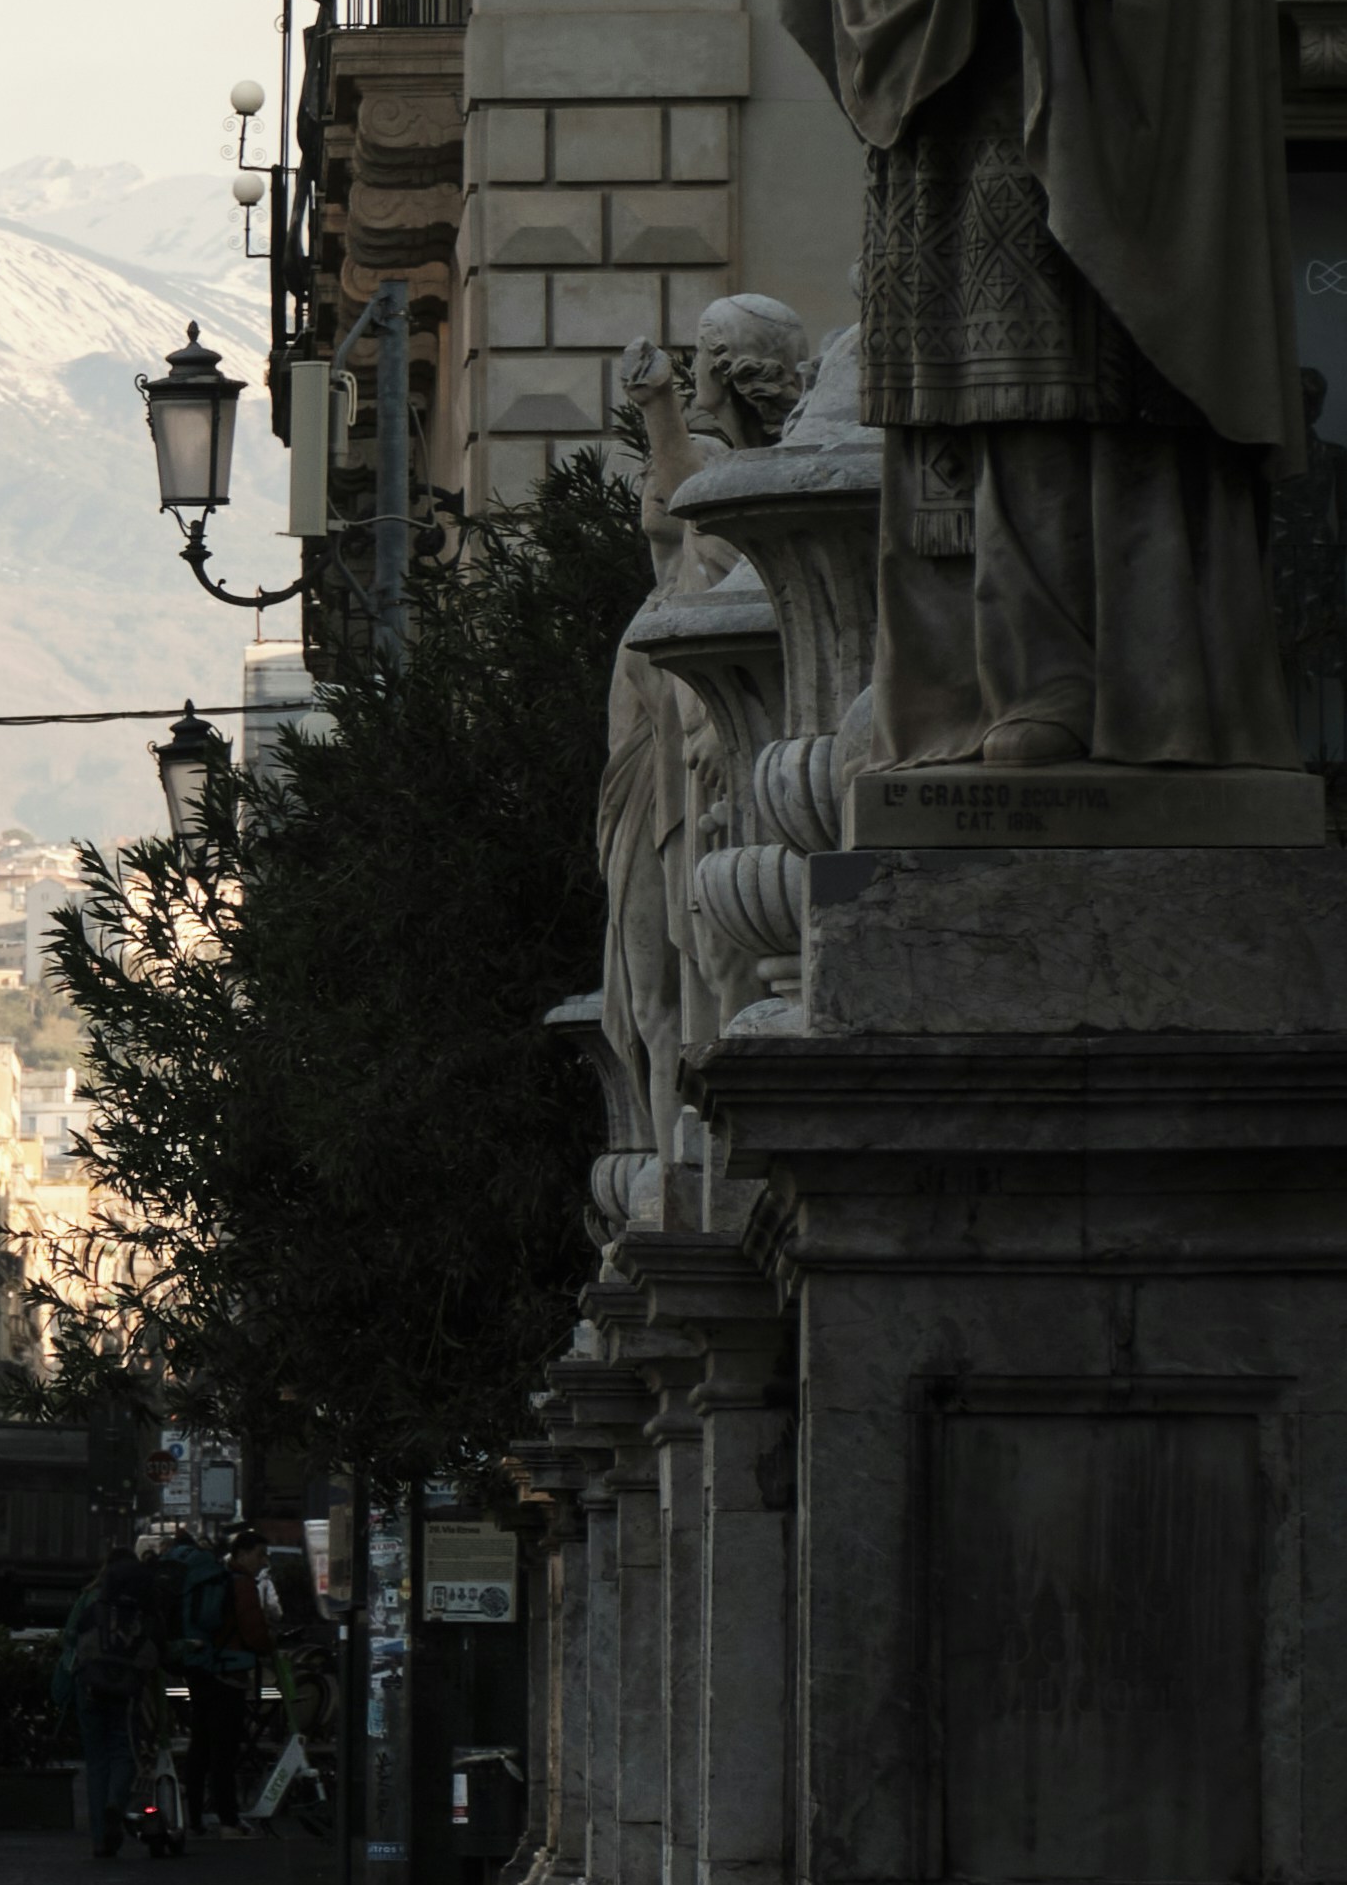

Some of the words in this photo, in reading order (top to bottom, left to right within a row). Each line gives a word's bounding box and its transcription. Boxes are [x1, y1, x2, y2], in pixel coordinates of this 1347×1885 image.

[920, 783, 1009, 807] GRASSO
[957, 812, 996, 831] CAT.
[146, 1461, 176, 1474] STOP
